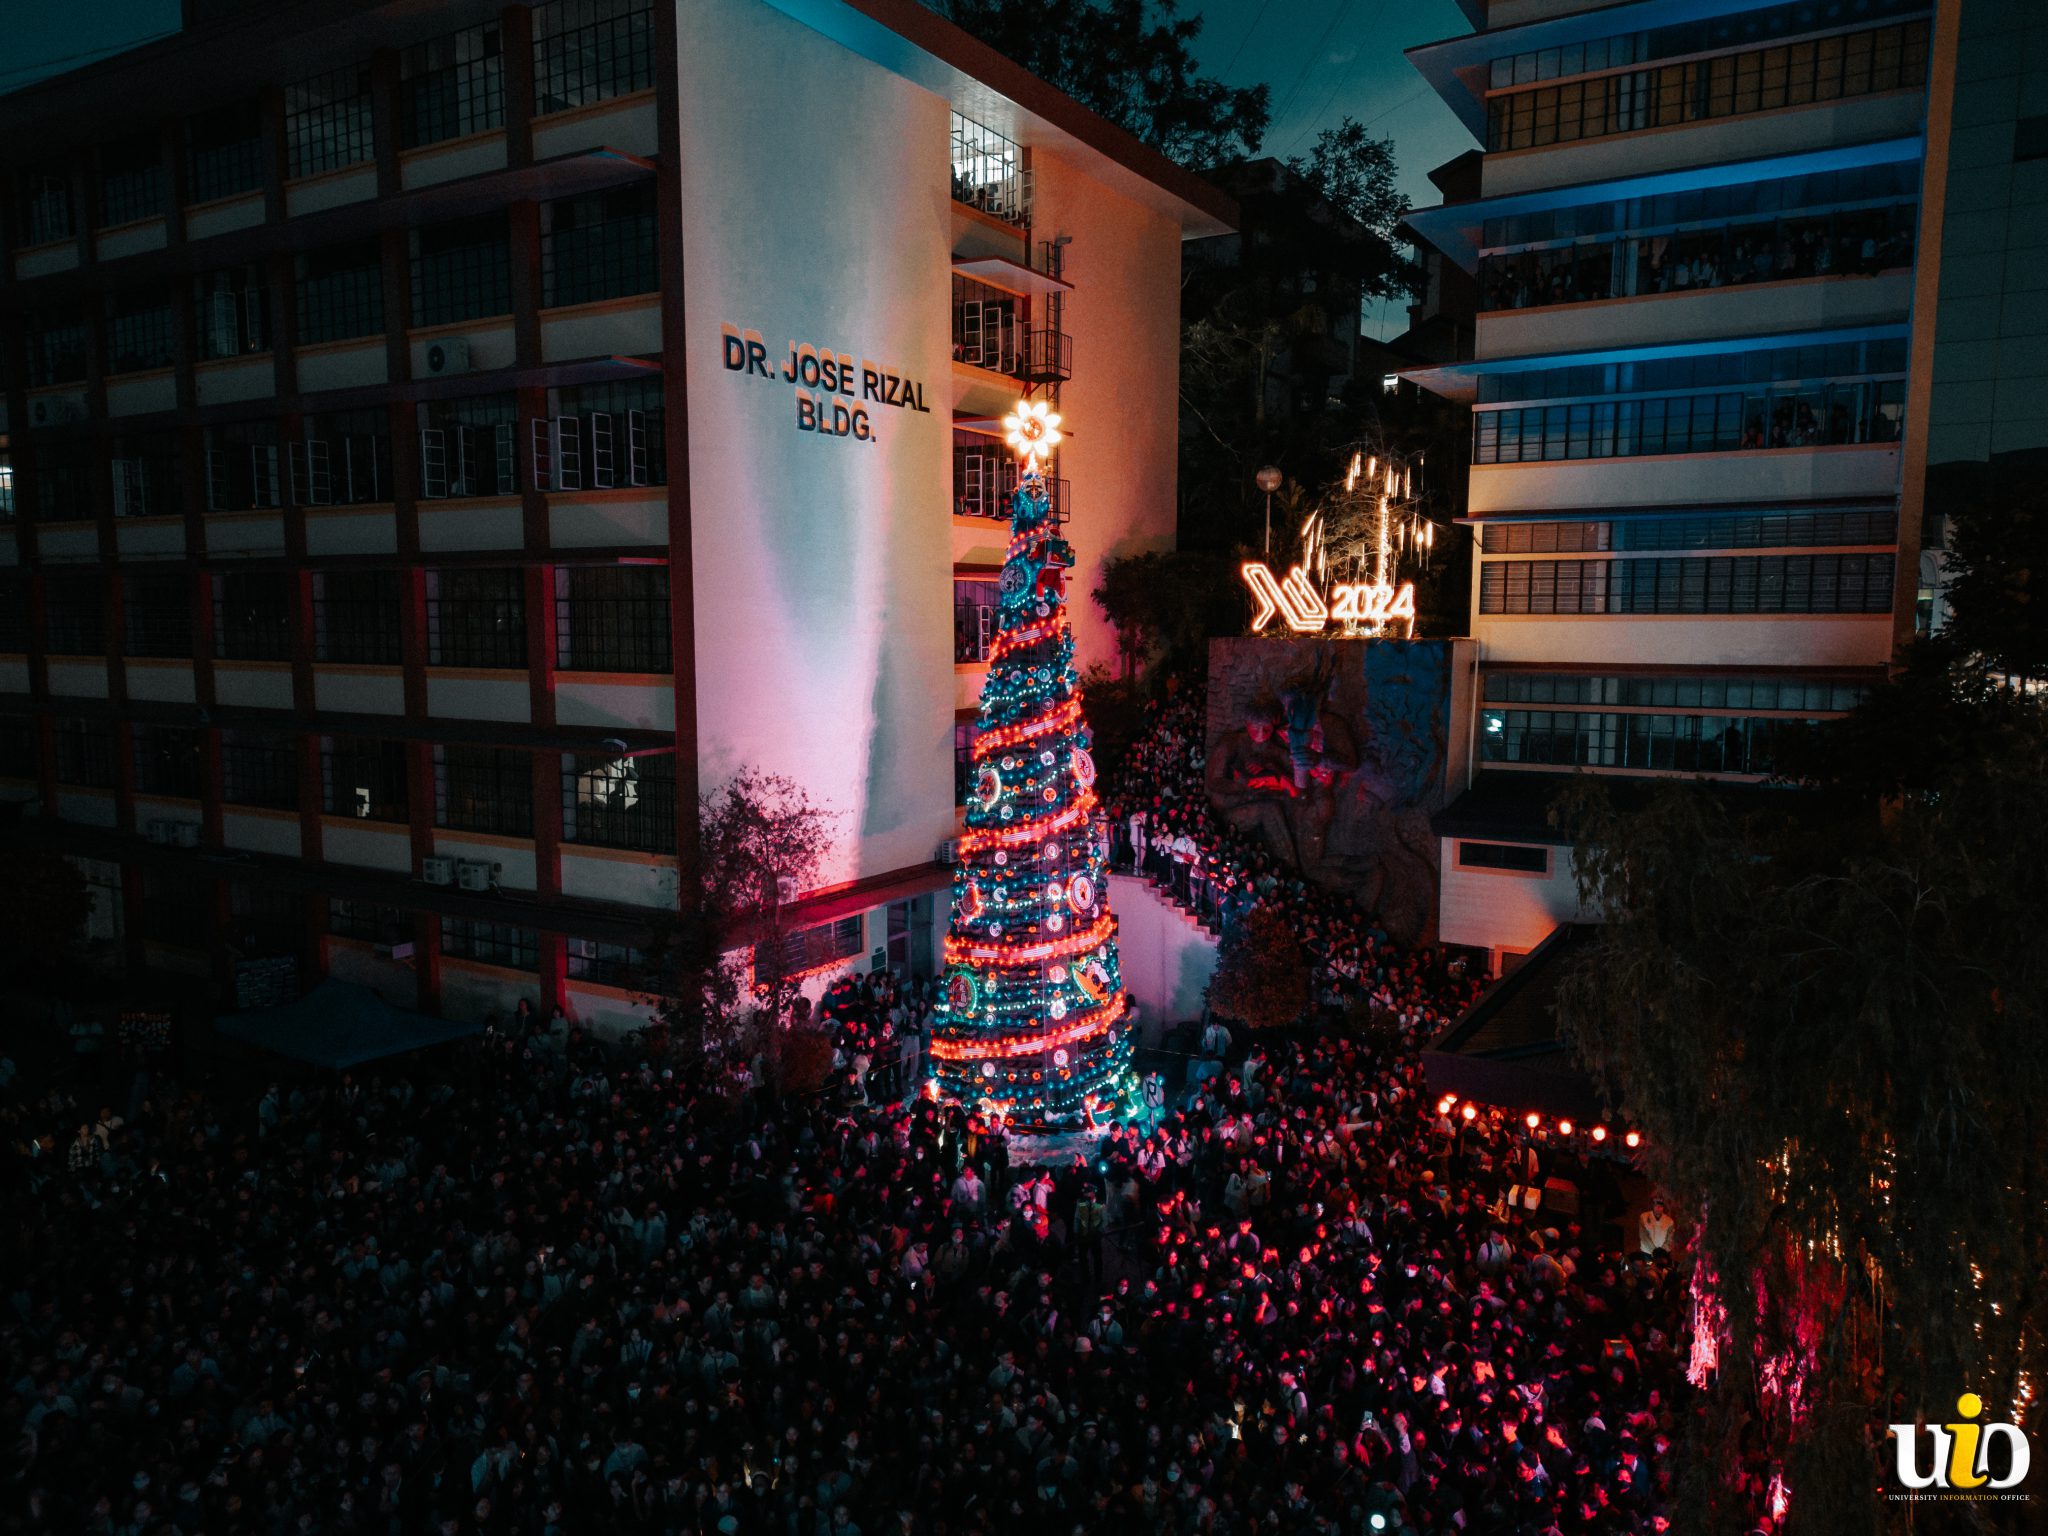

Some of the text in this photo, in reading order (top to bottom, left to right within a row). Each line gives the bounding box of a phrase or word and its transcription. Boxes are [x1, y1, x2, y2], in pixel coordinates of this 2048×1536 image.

[722, 330, 931, 413] DR. JOSE RIZAL
[796, 395, 877, 443] BLDG.
[1331, 581, 1415, 620] 2024
